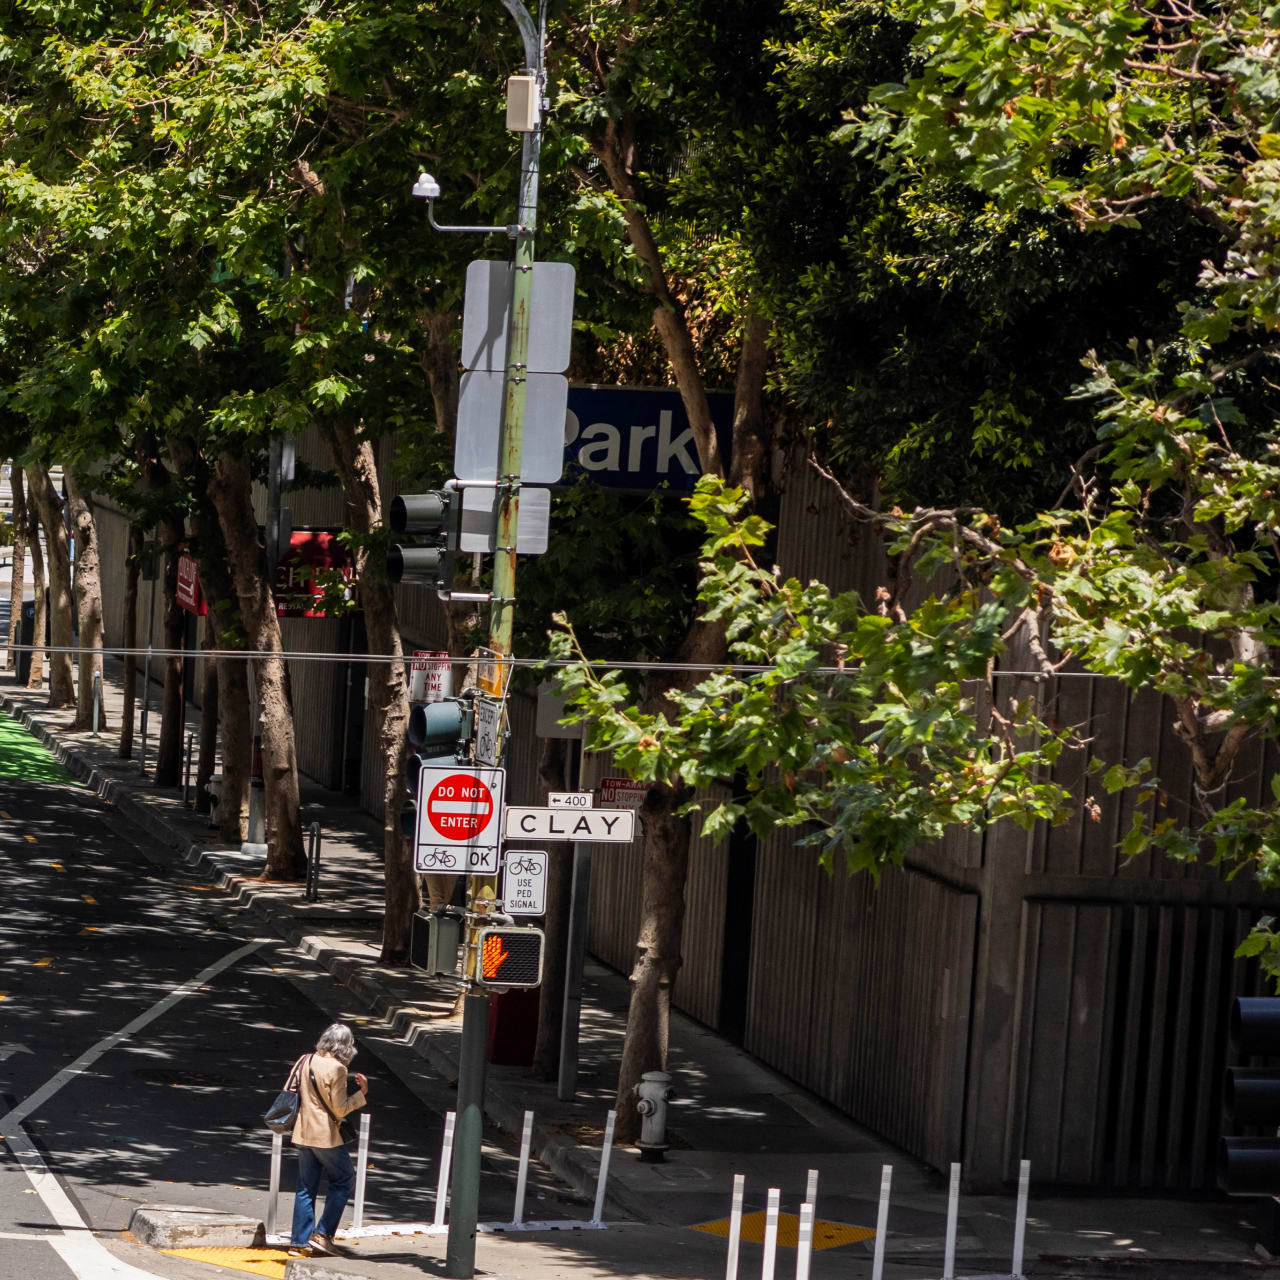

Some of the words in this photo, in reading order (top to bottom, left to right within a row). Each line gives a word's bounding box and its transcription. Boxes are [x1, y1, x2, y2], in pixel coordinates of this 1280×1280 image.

[426, 663, 451, 671] STOPPIN
[425, 673, 441, 681] ANY
[423, 682, 442, 691] TIME
[438, 786, 454, 798] DO
[461, 787, 485, 799] NOT
[601, 788, 615, 801] NO
[617, 791, 646, 802] STOPPIN
[564, 796, 587, 807] 400
[440, 816, 478, 829] ENTER
[520, 814, 620, 835] CLAY
[469, 851, 490, 867] OK
[517, 878, 532, 888] USE
[516, 889, 532, 898] PED
[509, 900, 538, 909] SIGNAL
